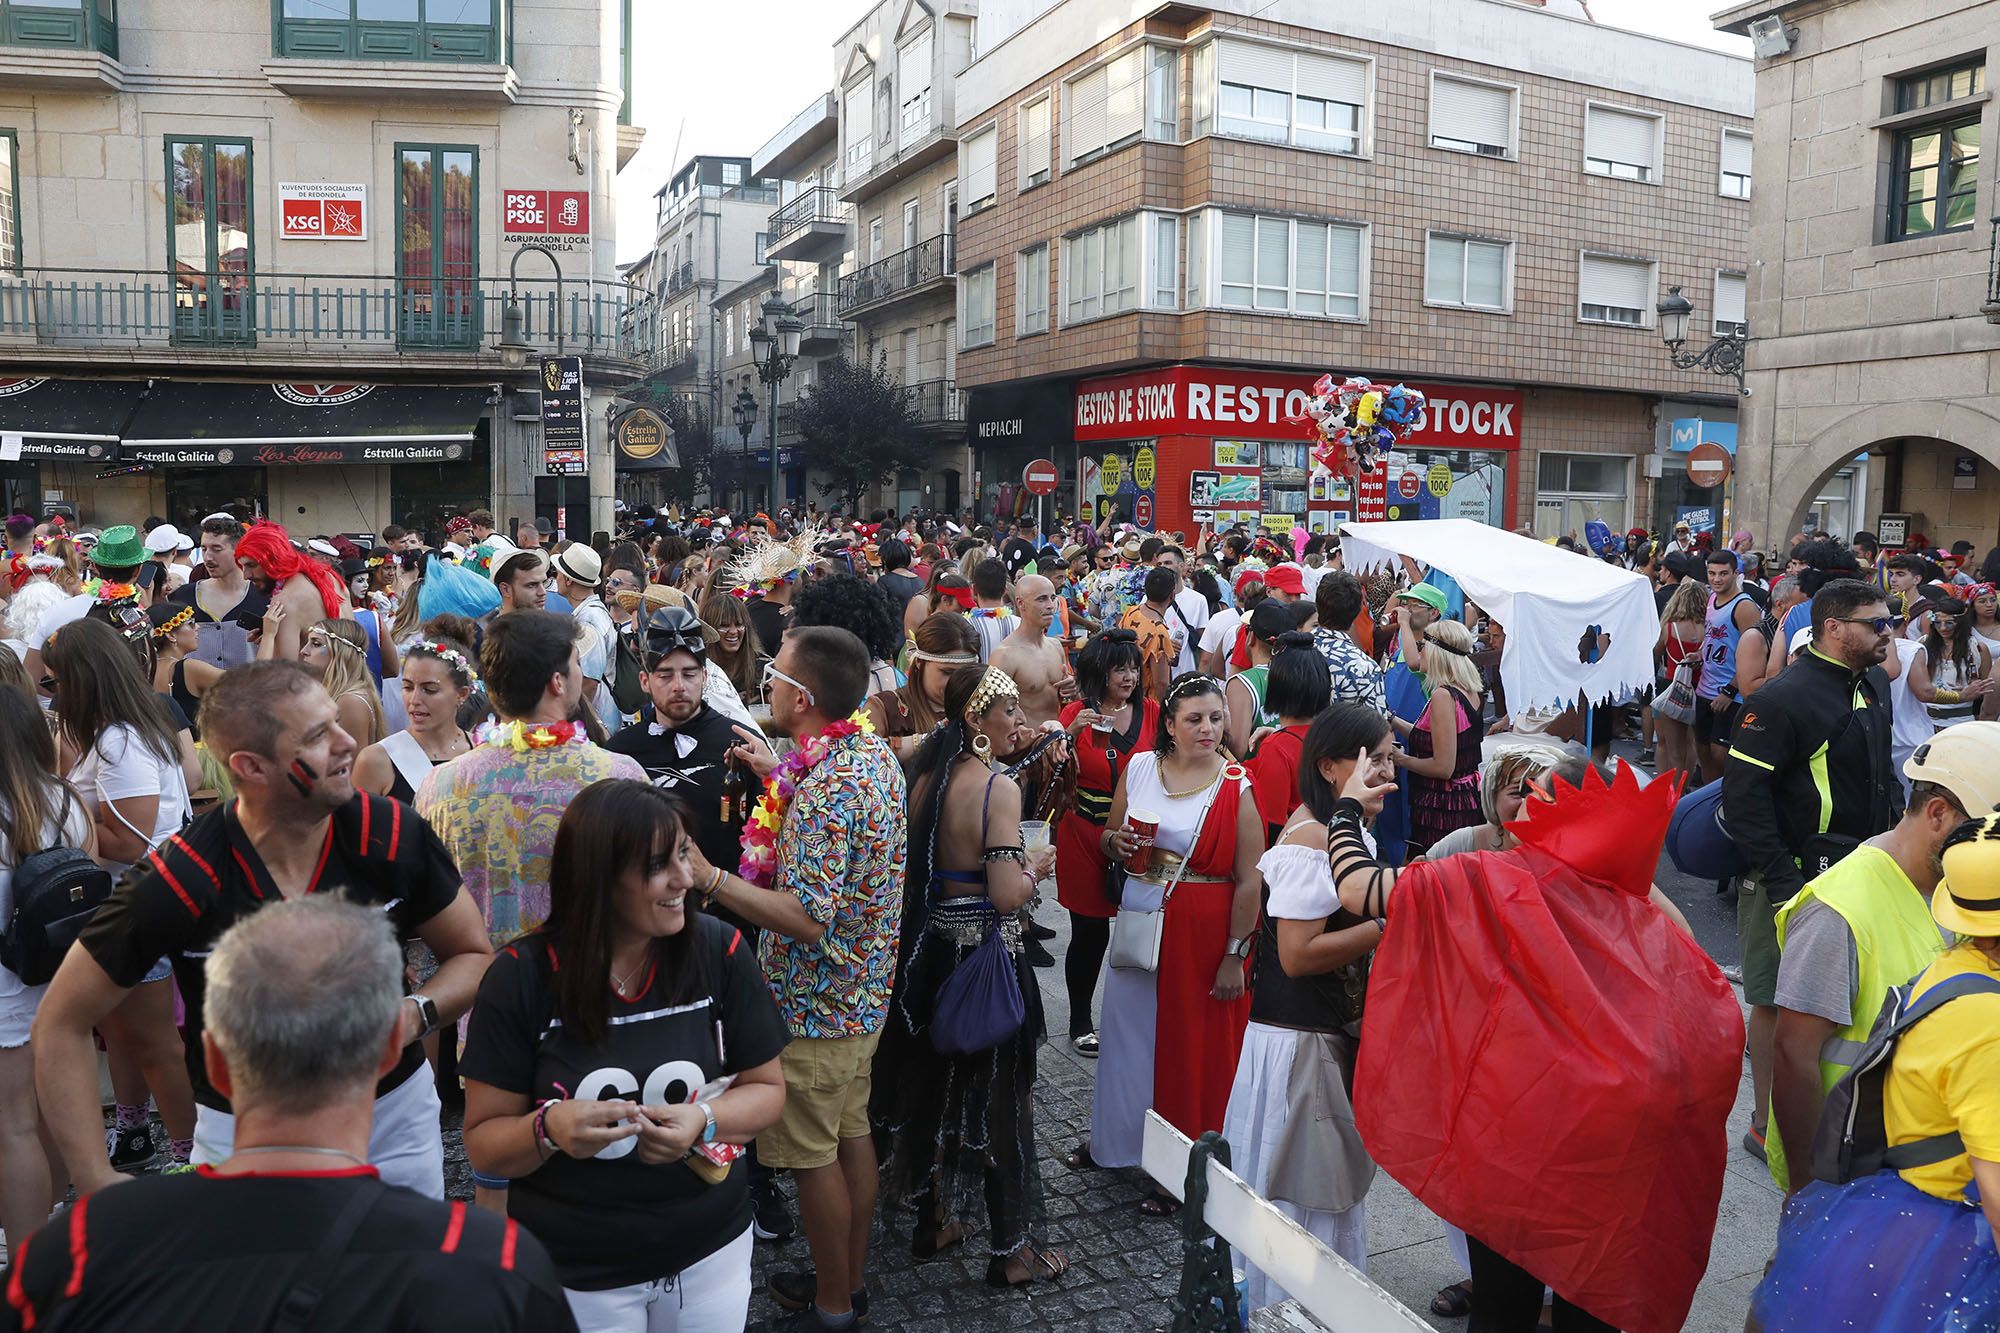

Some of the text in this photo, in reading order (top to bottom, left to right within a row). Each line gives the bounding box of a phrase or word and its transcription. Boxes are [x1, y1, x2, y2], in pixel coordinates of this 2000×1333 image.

[507, 194, 536, 209] PSG
[286, 215, 320, 230] XSG
[507, 209, 544, 224] PSOE
[504, 235, 560, 243] AGRUPACION
[322, 391, 359, 403] DESDE
[1188, 383, 1309, 424] RESTO
[1077, 383, 1176, 426] RESTOS DE STOCK
[626, 425, 657, 435] Estrella
[979, 419, 1023, 438] MEPIACHI
[627, 434, 656, 444] Galicia
[53, 444, 86, 455] Galicia
[363, 447, 443, 459] Estrella Galicia
[177, 451, 215, 462] Galicia
[1103, 472, 1118, 485] 100€
[1137, 468, 1151, 481] 100€
[1431, 480, 1448, 491] 100€
[1705, 644, 1728, 665] 14
